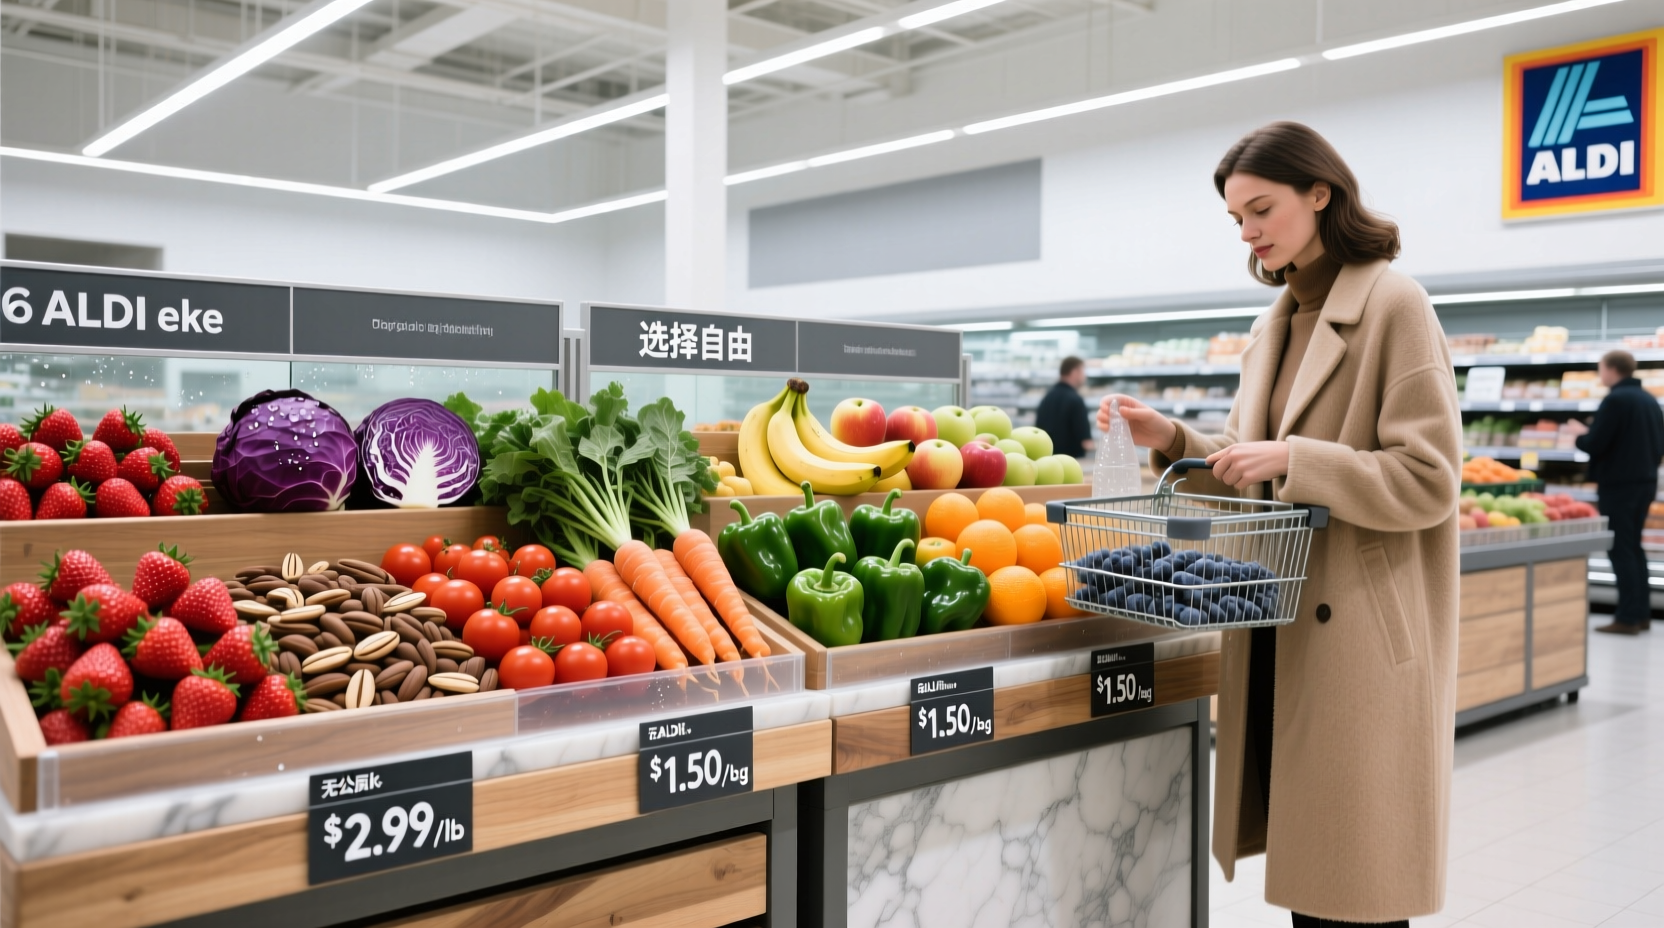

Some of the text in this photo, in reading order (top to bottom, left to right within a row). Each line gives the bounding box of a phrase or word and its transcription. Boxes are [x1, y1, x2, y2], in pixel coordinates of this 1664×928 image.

[1526, 140, 1635, 186] ALDI
[1, 286, 223, 334] 6 ALDI eke
[638, 320, 752, 363] 选择自由
[918, 703, 992, 739] $1.50/bg
[649, 748, 749, 794] $1.50/bg
[323, 801, 465, 862] $2.99/lb
